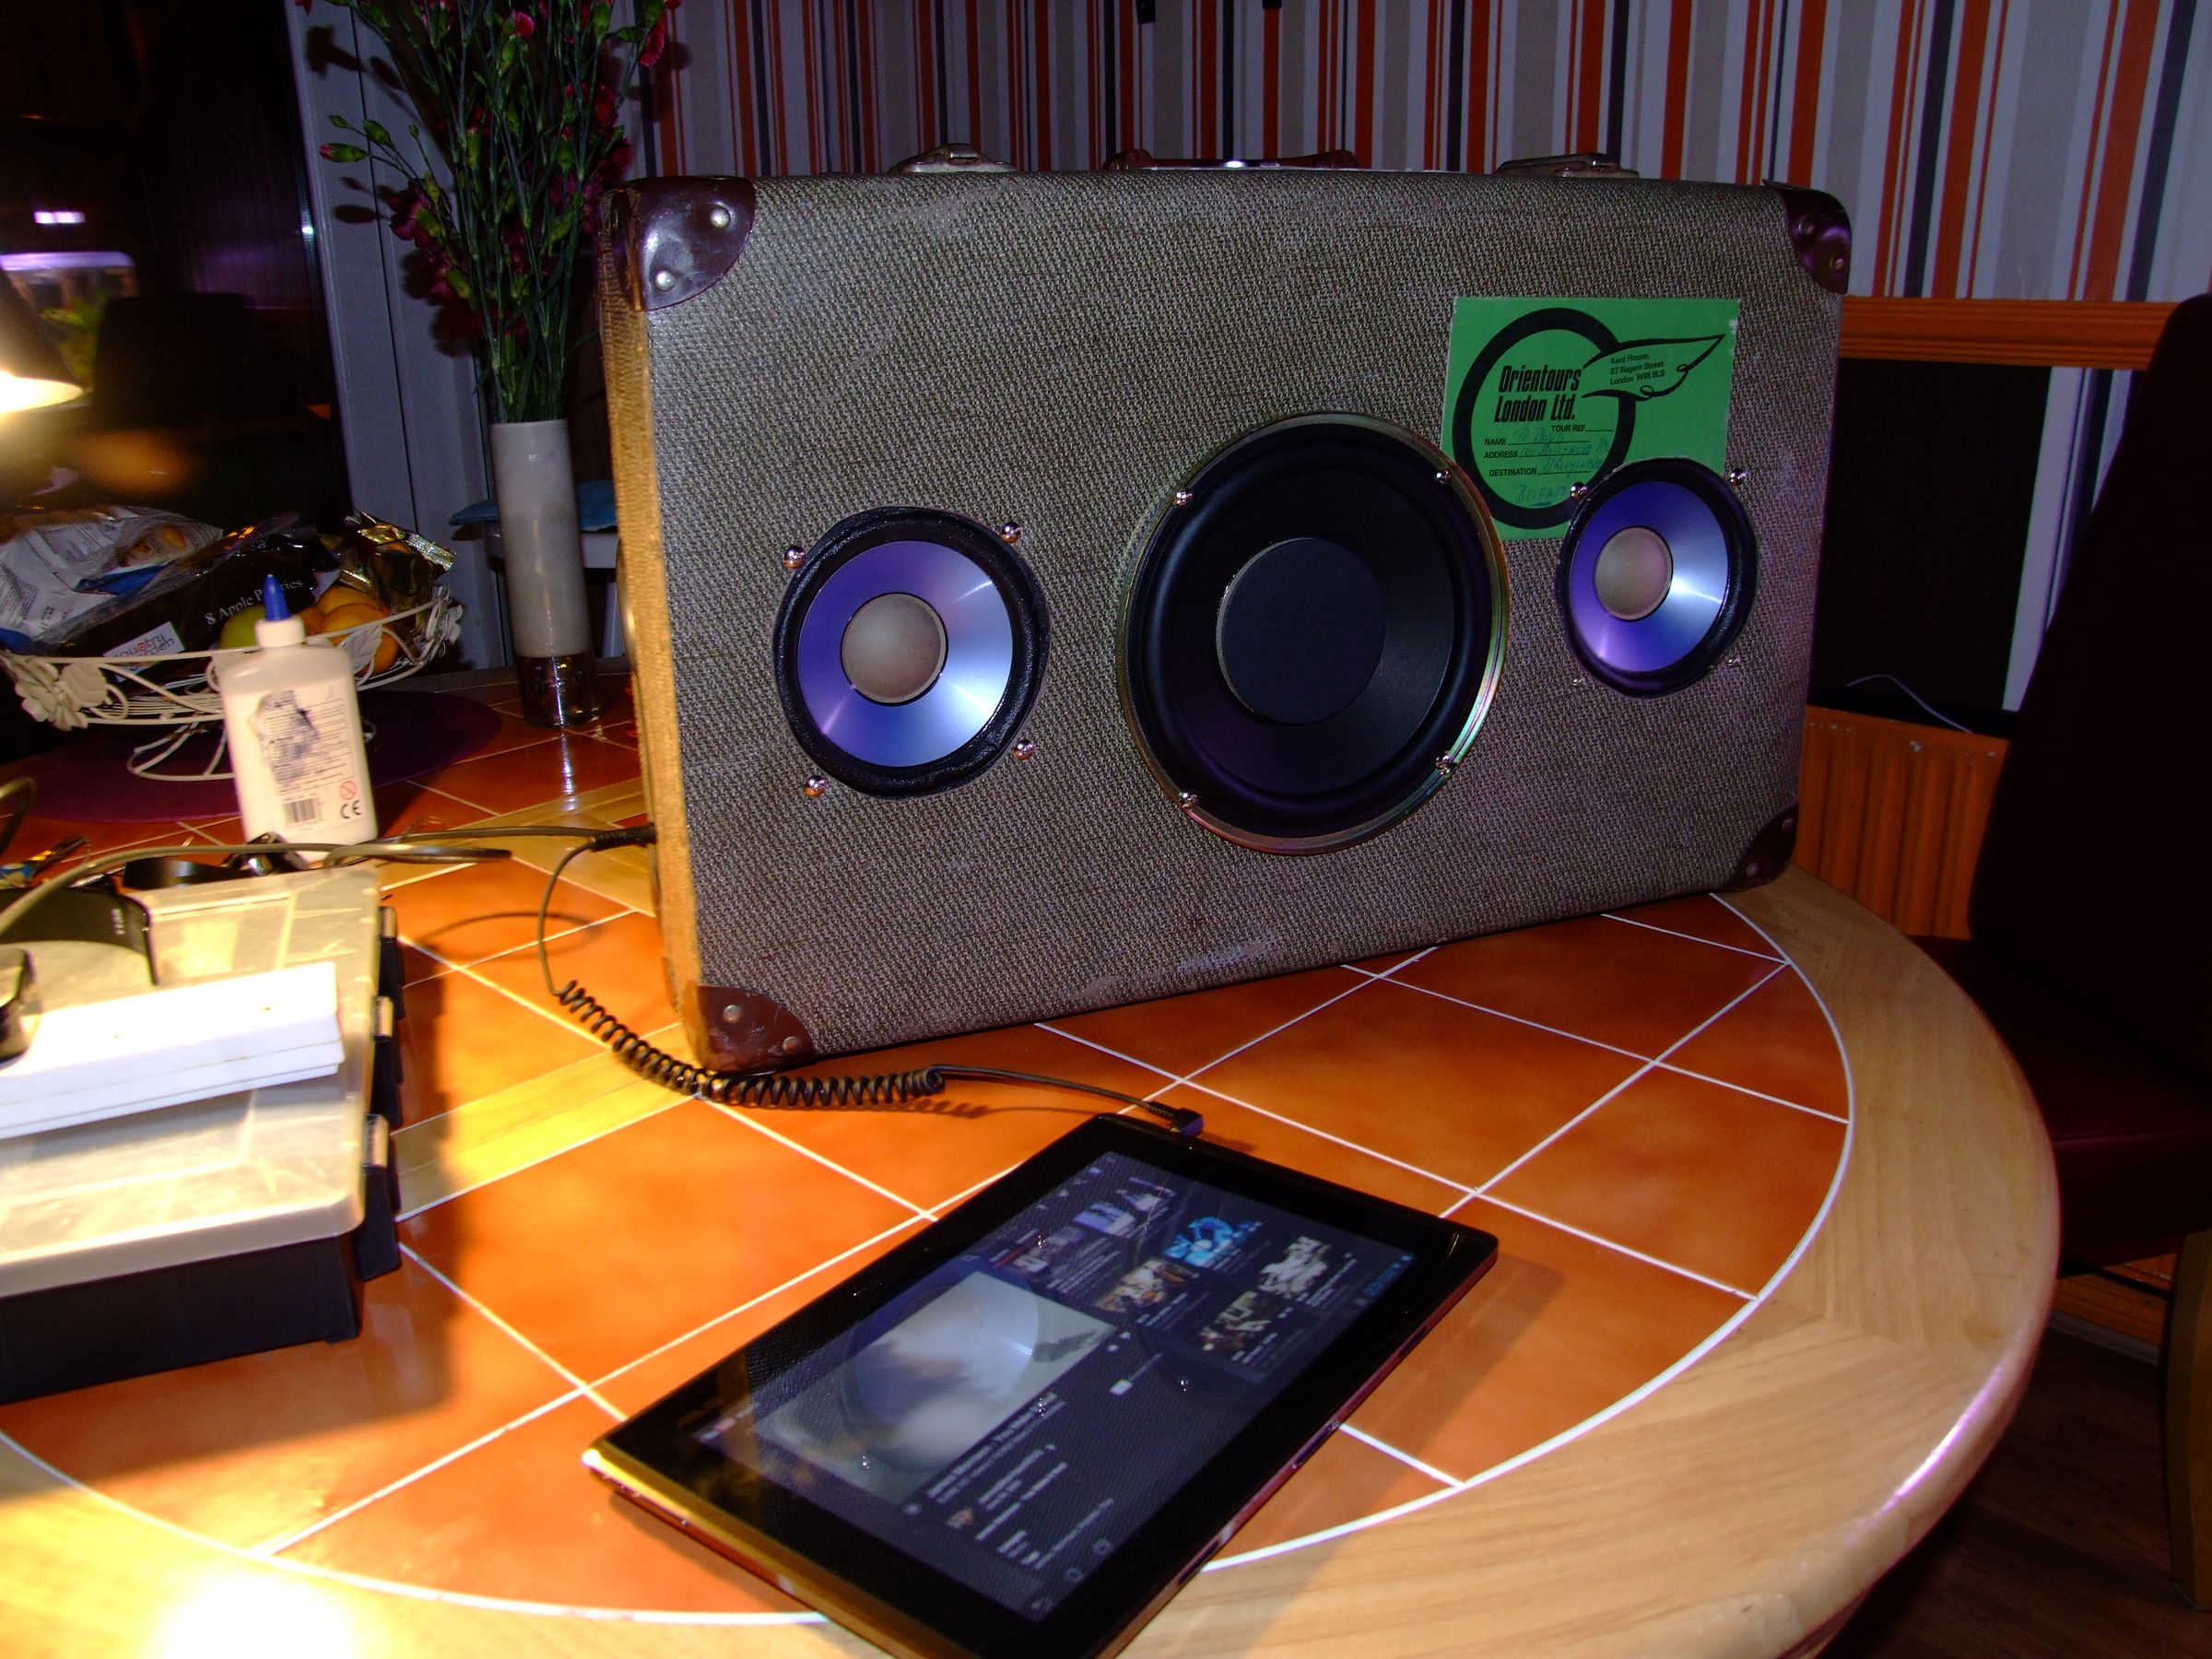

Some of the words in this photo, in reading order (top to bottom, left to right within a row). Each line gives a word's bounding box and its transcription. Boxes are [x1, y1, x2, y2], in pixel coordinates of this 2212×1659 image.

[1610, 356, 1626, 364] Kent
[1619, 364, 1642, 374] Regent
[1643, 361, 1665, 370] Street
[1498, 365, 1583, 393] Orientours
[1610, 376, 1634, 385] London
[1494, 395, 1547, 423] London
[1549, 393, 1576, 421] Ltd.
[1571, 424, 1586, 432] REF
[1484, 438, 1507, 446] NAME
[1483, 451, 1519, 459] ADDRESS
[1488, 467, 1536, 477] DESTINATION
[205, 612, 216, 626] 8
[218, 596, 253, 620] Apple
[253, 579, 304, 602] Pries
